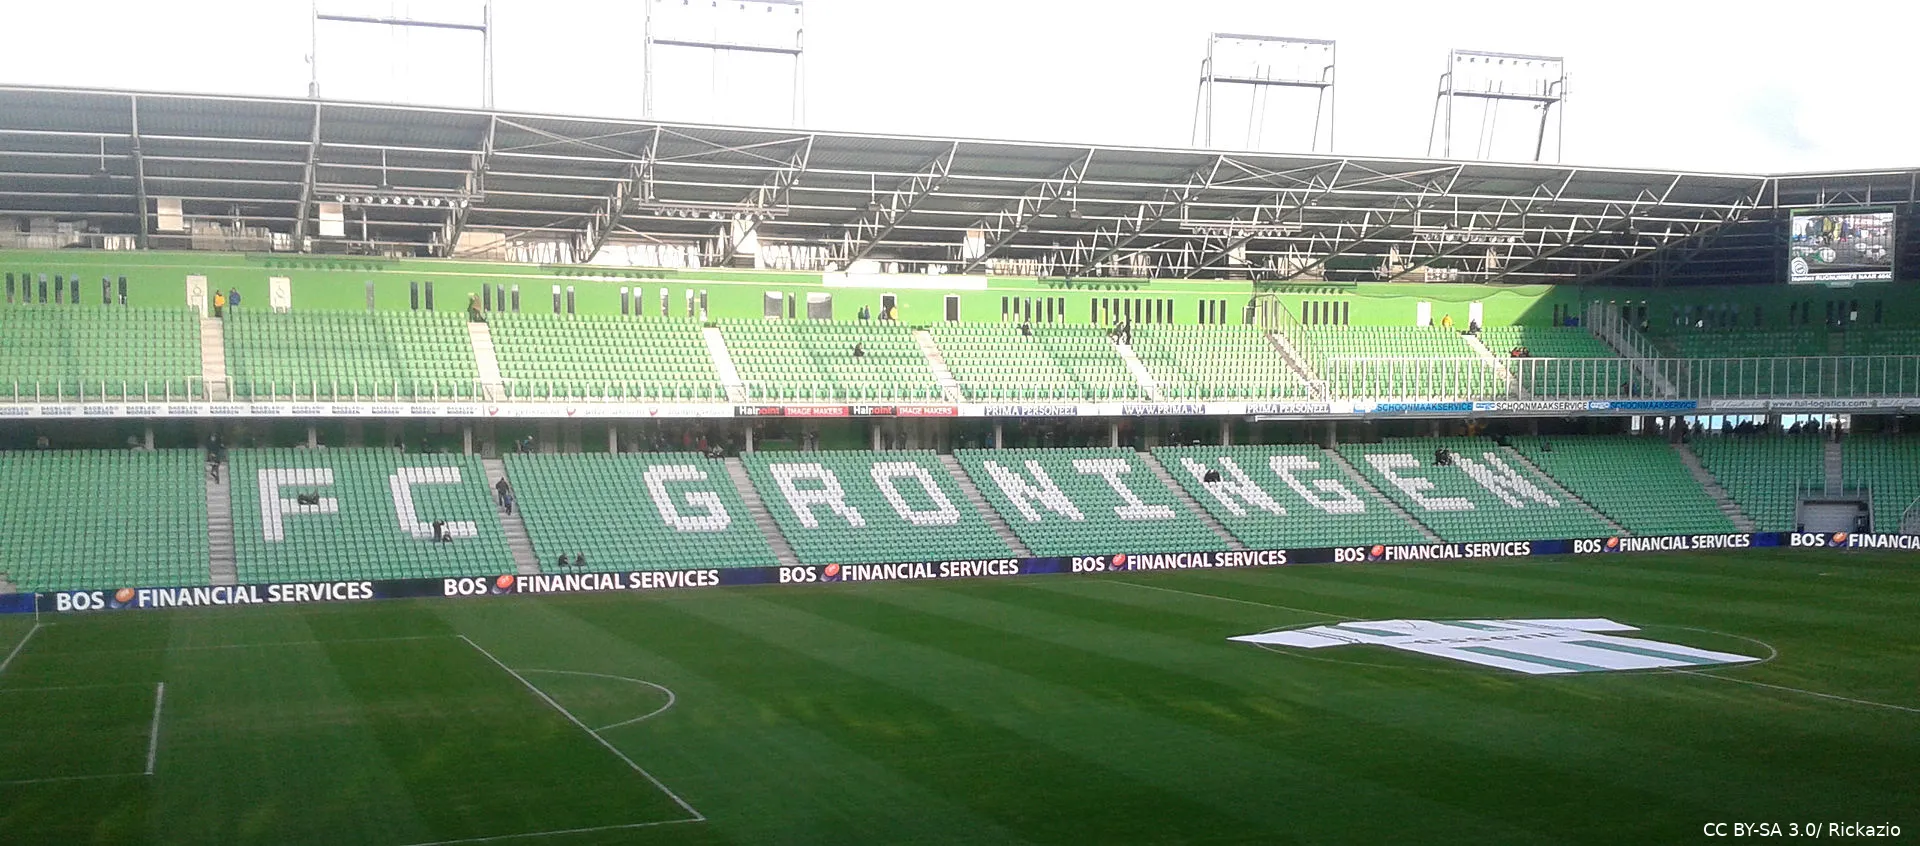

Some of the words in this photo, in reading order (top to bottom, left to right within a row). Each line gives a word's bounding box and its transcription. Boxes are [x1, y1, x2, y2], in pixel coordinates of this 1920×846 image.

[987, 405, 1018, 416] PRIMA
[1022, 405, 1077, 416] PERSONEEL
[1123, 404, 1205, 415] WWW.PRIMA.NL
[1247, 403, 1277, 414] PRIMA
[1280, 403, 1330, 414] PERSONEEL
[1377, 402, 1473, 412] SCHOONMAAKSERVICE
[1496, 402, 1588, 411] SCHOONMAAKSERVICE
[1610, 401, 1697, 410] SCHOONMAAKSERVICE
[257, 467, 479, 542] FC
[642, 452, 1561, 531] GRONINGEN
[1573, 538, 1601, 554] BOS
[1619, 536, 1689, 552] FINANCIAL
[1692, 533, 1750, 550] SERVICES
[1790, 532, 1825, 547] BOS
[1334, 546, 1364, 563] BOS
[1385, 543, 1462, 560] FINANCIAL
[1465, 540, 1530, 557] SERVICES
[1072, 556, 1105, 573] BOS
[1127, 553, 1212, 571] FINANCIAL
[1215, 549, 1287, 567] SERVICES
[779, 566, 816, 584] BOS
[842, 562, 937, 582] FINANCIAL
[940, 558, 1019, 578] SERVICES
[444, 577, 487, 597] BOS
[517, 574, 626, 594] FINANCIAL
[629, 570, 720, 590] SERVICES
[57, 591, 105, 613] BOS
[139, 585, 263, 608] FINANCIAL
[268, 580, 373, 604] SERVICES
